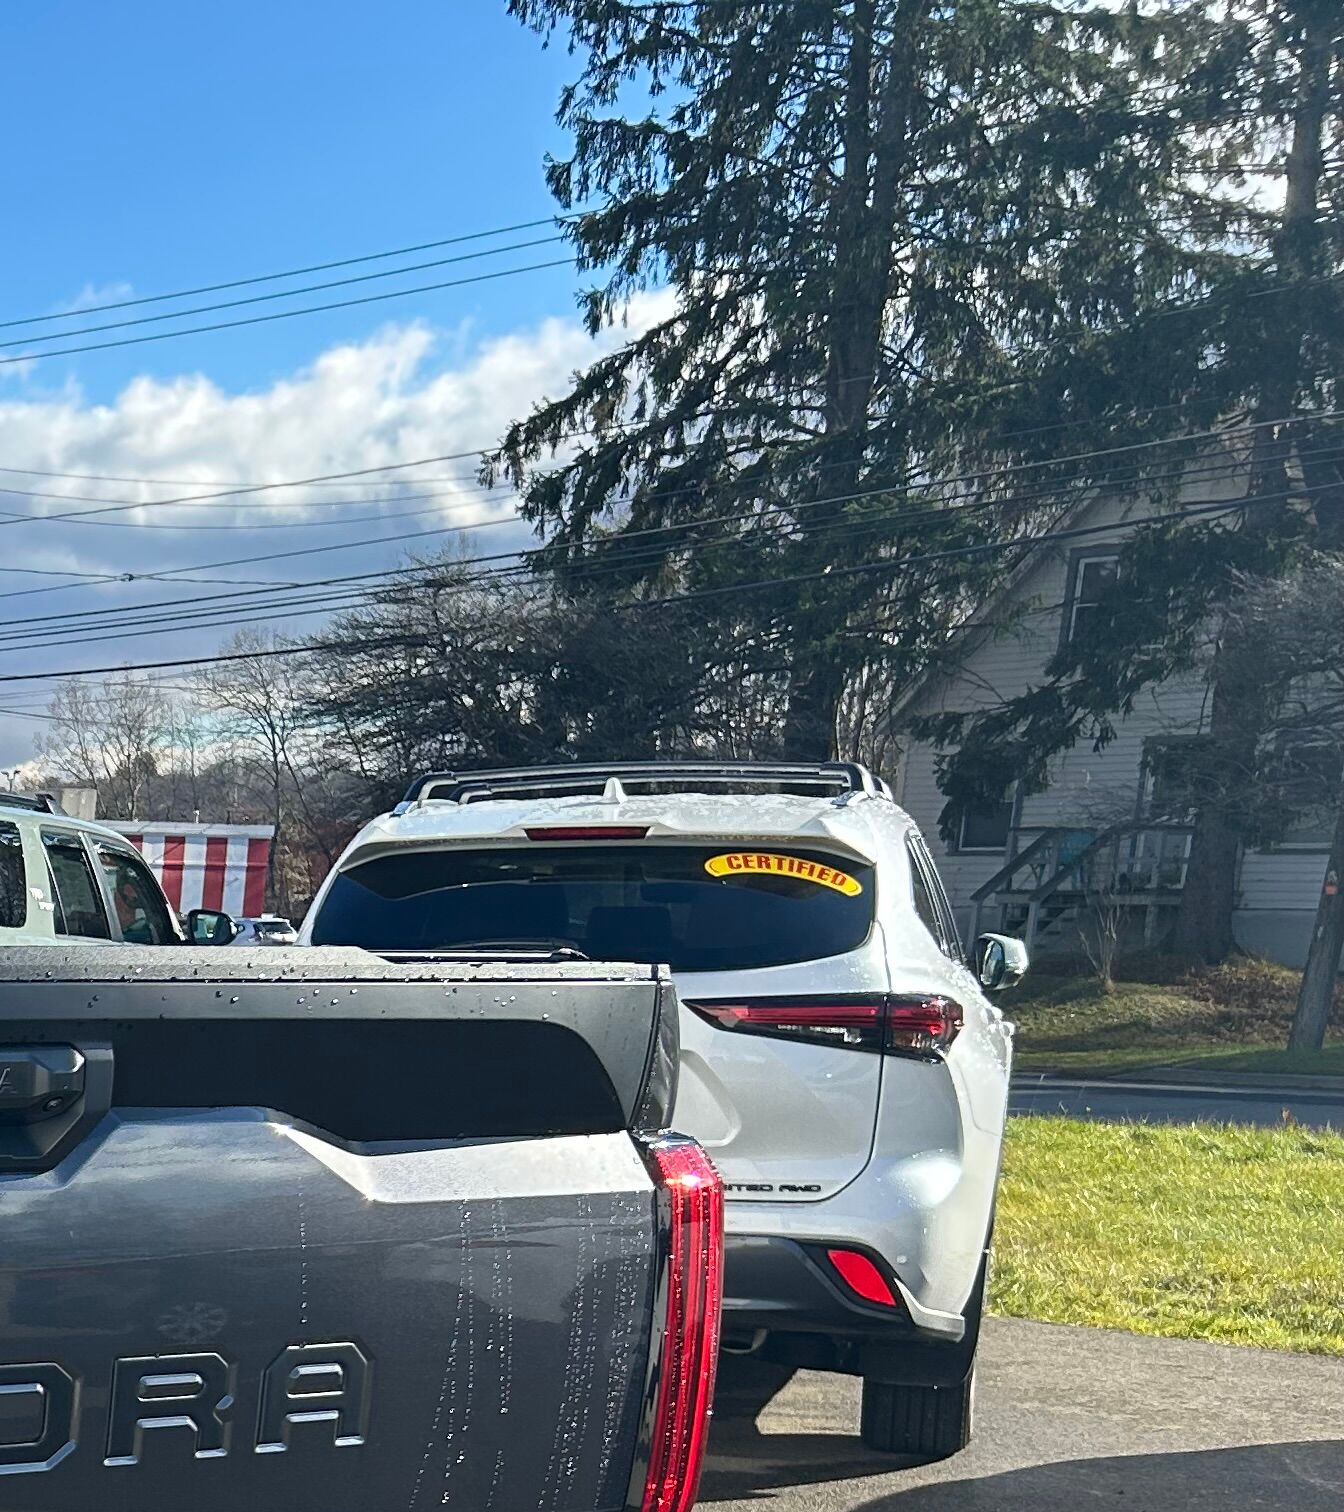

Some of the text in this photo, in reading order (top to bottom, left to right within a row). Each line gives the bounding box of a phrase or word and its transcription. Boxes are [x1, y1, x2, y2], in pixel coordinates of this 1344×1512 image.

[726, 855, 848, 887] CERTIFIED
[724, 1184, 822, 1193] ITED AWD
